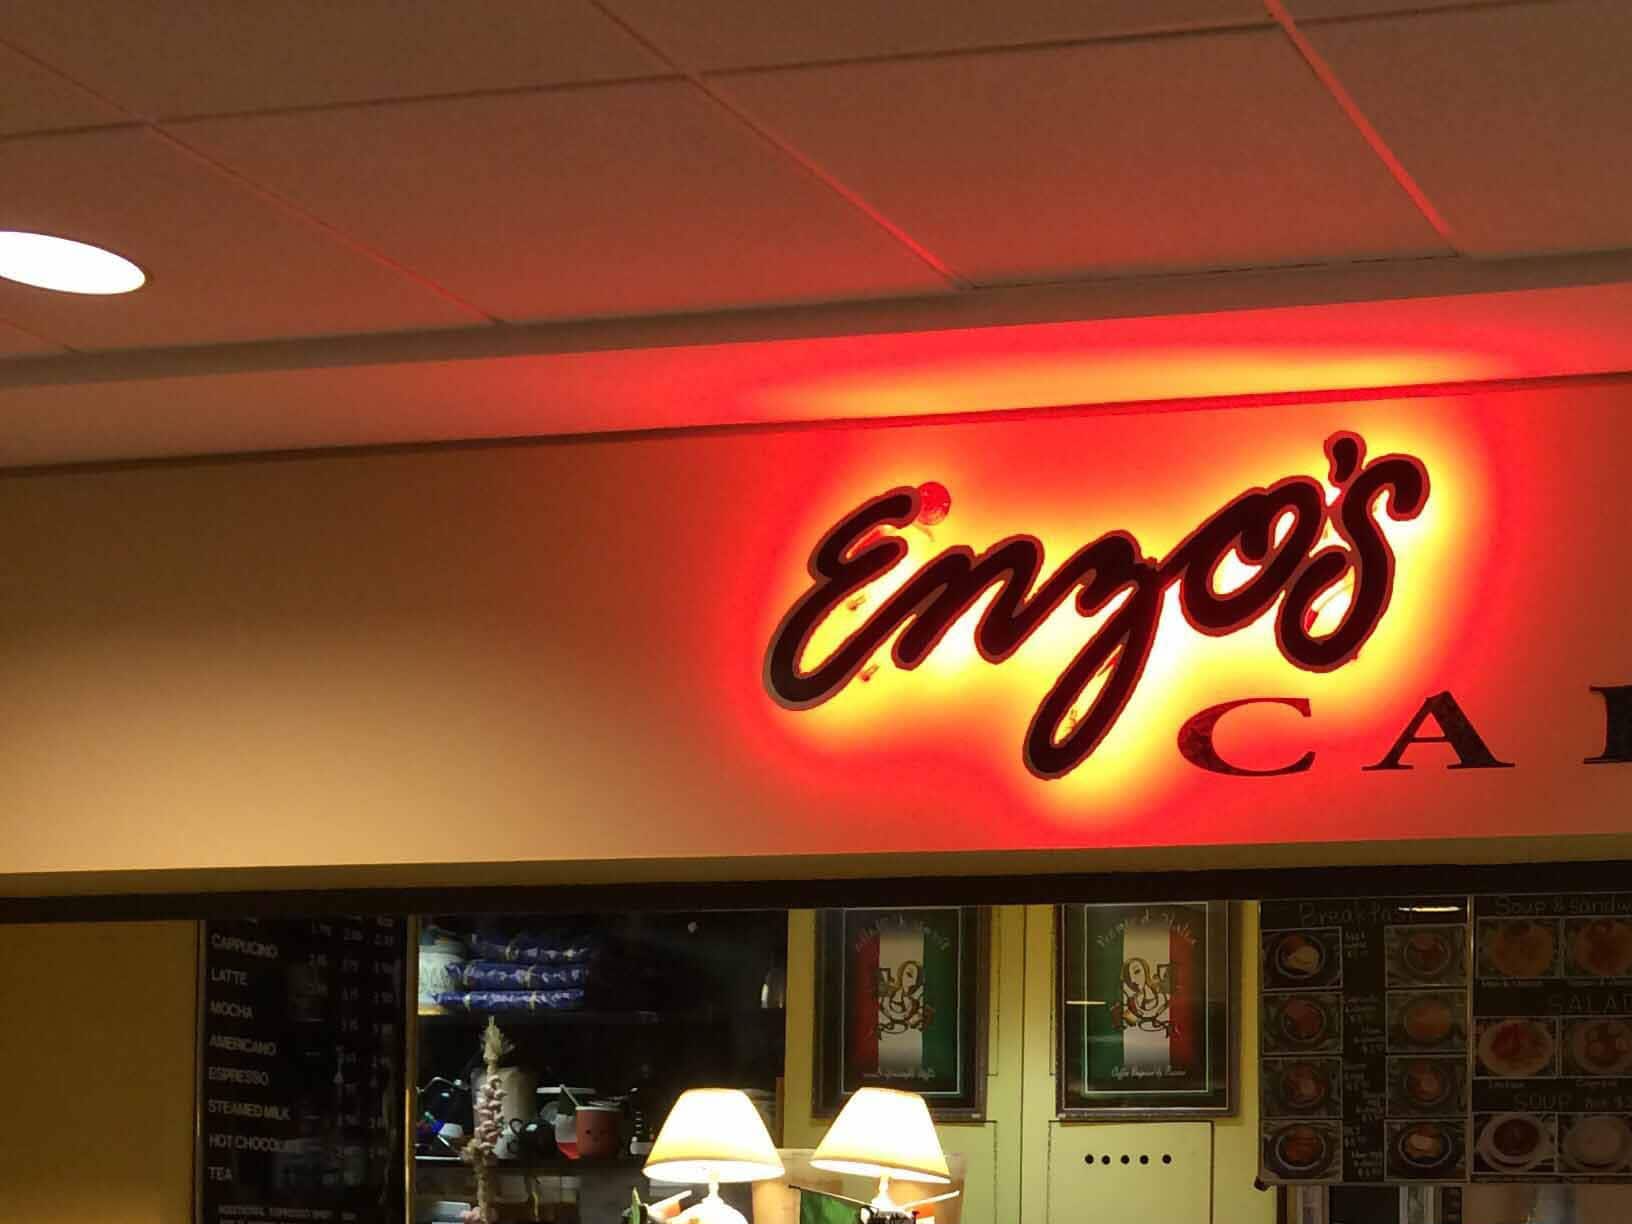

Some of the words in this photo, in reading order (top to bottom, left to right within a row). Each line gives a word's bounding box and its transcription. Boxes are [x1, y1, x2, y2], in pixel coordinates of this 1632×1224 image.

[764, 431, 1428, 779] Enzo's
[210, 966, 249, 987] LATTE
[209, 998, 256, 1020] MOCHA
[208, 1164, 233, 1182] TEA
